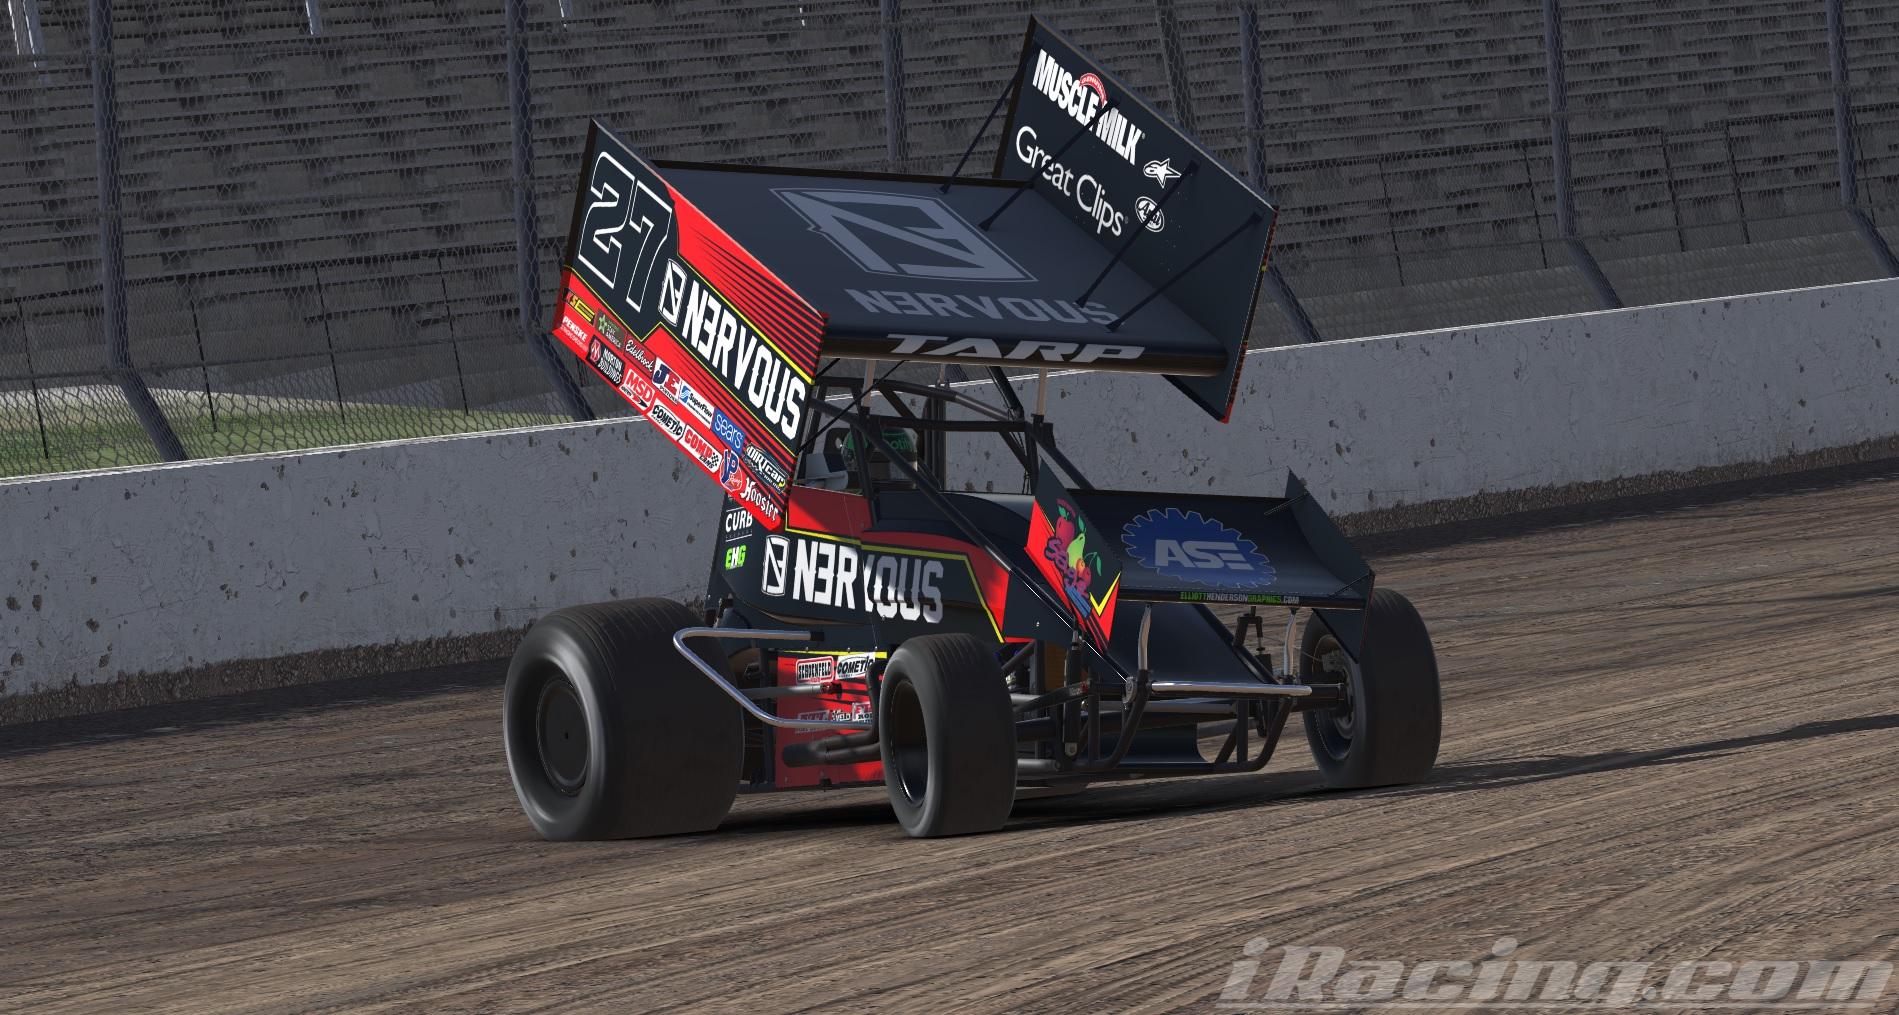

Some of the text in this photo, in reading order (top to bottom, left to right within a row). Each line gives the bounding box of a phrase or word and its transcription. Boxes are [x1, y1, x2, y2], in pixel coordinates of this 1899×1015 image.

[1032, 48, 1142, 166] MUSCLE MILK
[1016, 125, 1124, 236] Great Clips
[578, 151, 672, 312] 27
[562, 315, 588, 342] PENSKE
[602, 348, 622, 372] MORTON
[625, 339, 653, 372] Edelbrock
[886, 333, 1146, 363] TARP
[598, 358, 622, 384] BUILDINGS
[626, 372, 654, 402] MSD
[652, 404, 683, 436] COMETIC
[714, 413, 744, 449] sears
[684, 428, 714, 458] COMP
[740, 477, 778, 521] Hoosier
[725, 509, 752, 532] CURB
[725, 545, 746, 570] EHG
[1155, 539, 1254, 570] ASE
[798, 661, 831, 680] SCHOENFELD
